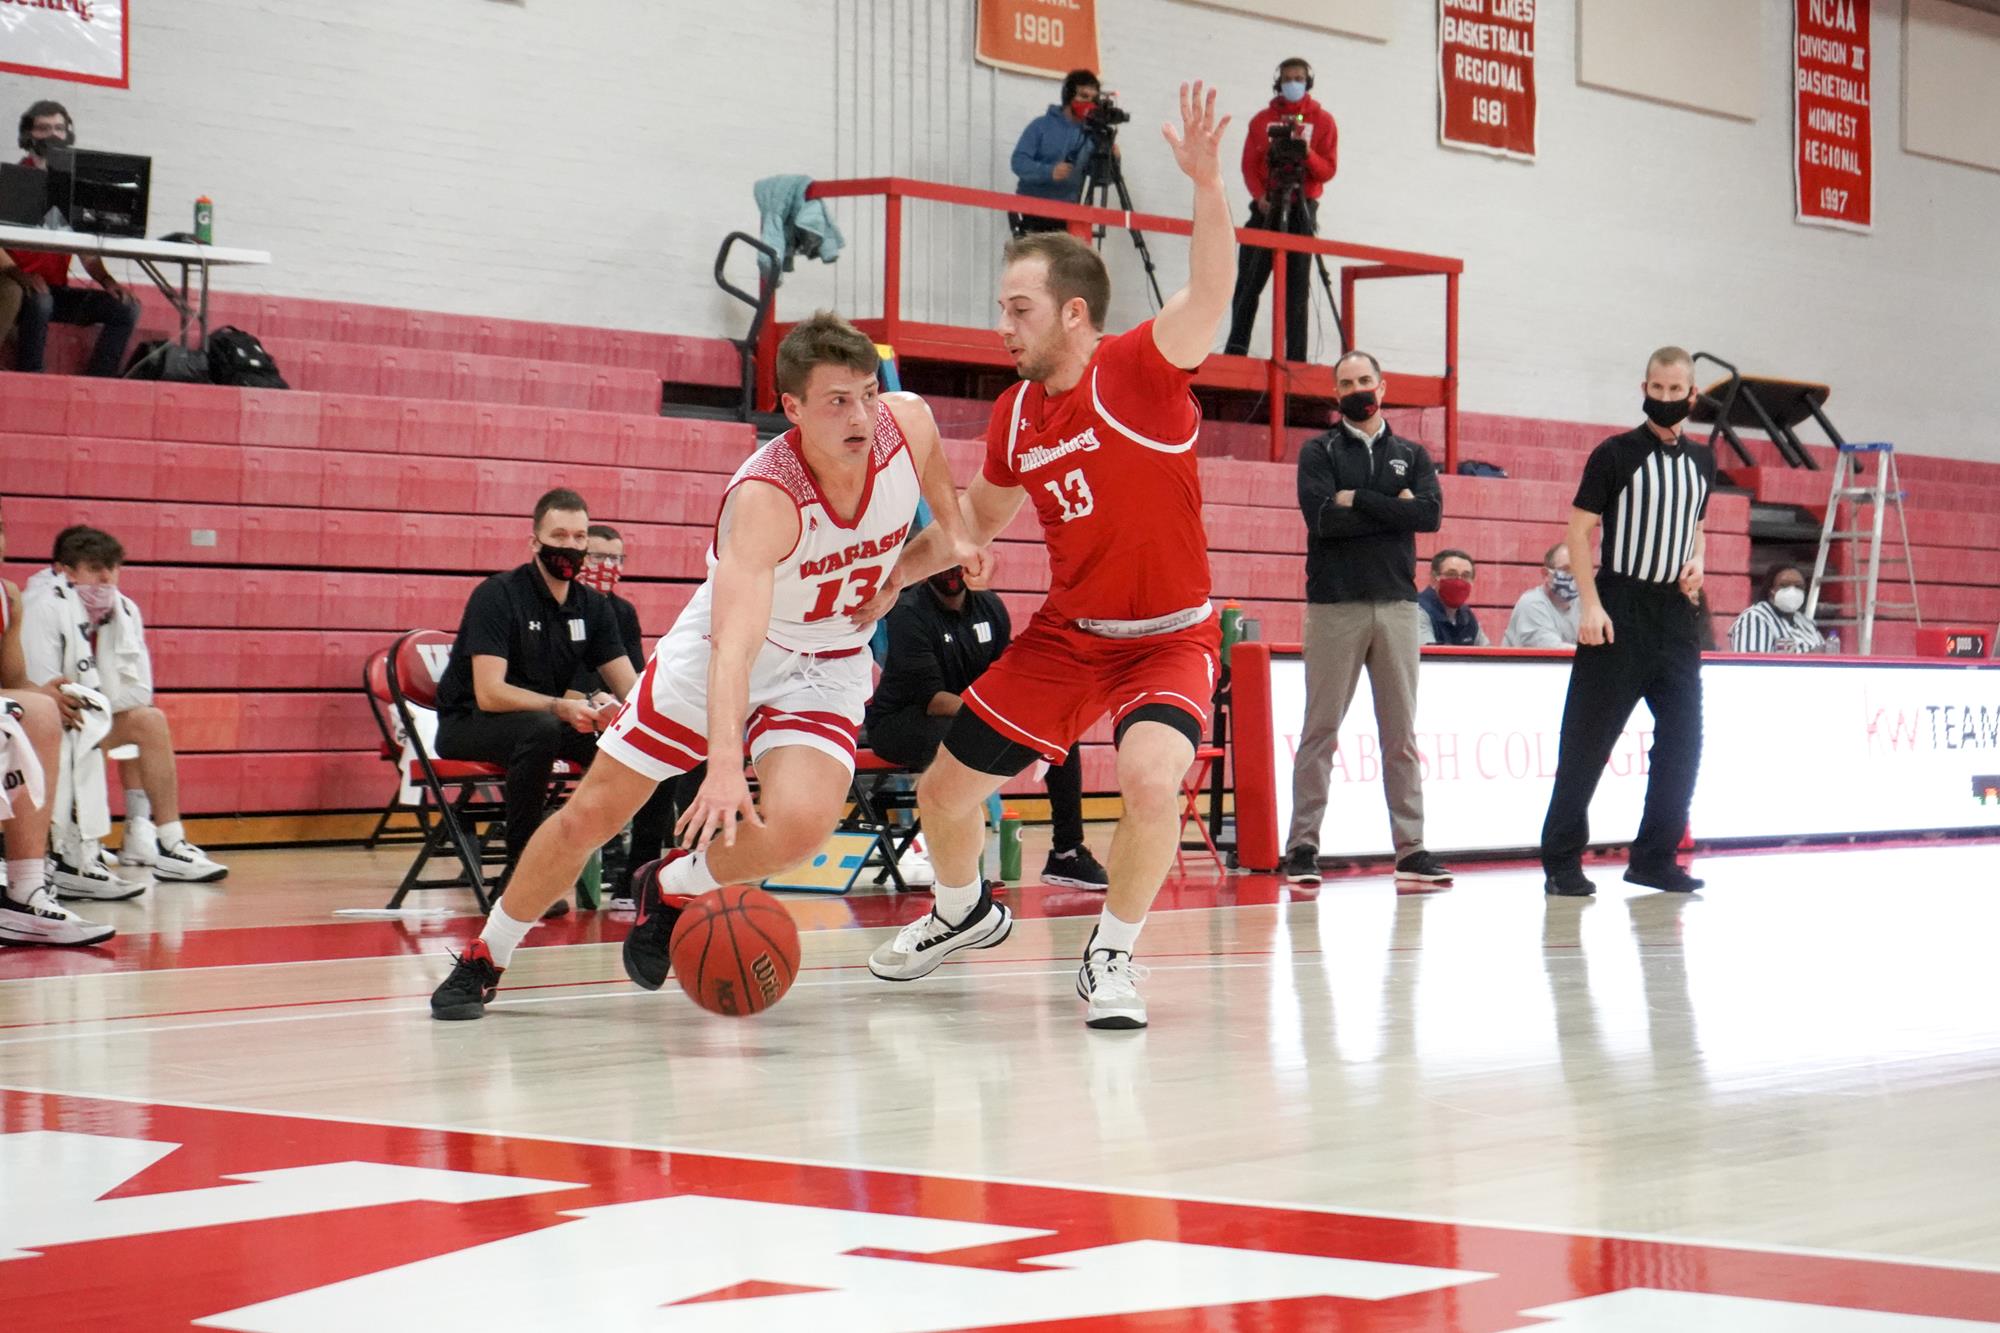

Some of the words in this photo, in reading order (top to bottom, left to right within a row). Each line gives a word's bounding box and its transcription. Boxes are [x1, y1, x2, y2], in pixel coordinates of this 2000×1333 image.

[1014, 11, 1065, 48] 1980
[1809, 0, 1857, 33] NCAA
[1444, 16, 1534, 58] BASKETBALL
[1800, 33, 1847, 66] DIVISION
[1455, 52, 1525, 93] REGIONAL
[1798, 67, 1869, 106] BASKETBALL
[1472, 96, 1508, 127] 1981
[1808, 107, 1857, 140] MIDWEST
[1804, 138, 1862, 176] REGIONAL
[1820, 186, 1849, 214] 1997
[1044, 468, 1094, 522] 13
[803, 565, 882, 622] 13
